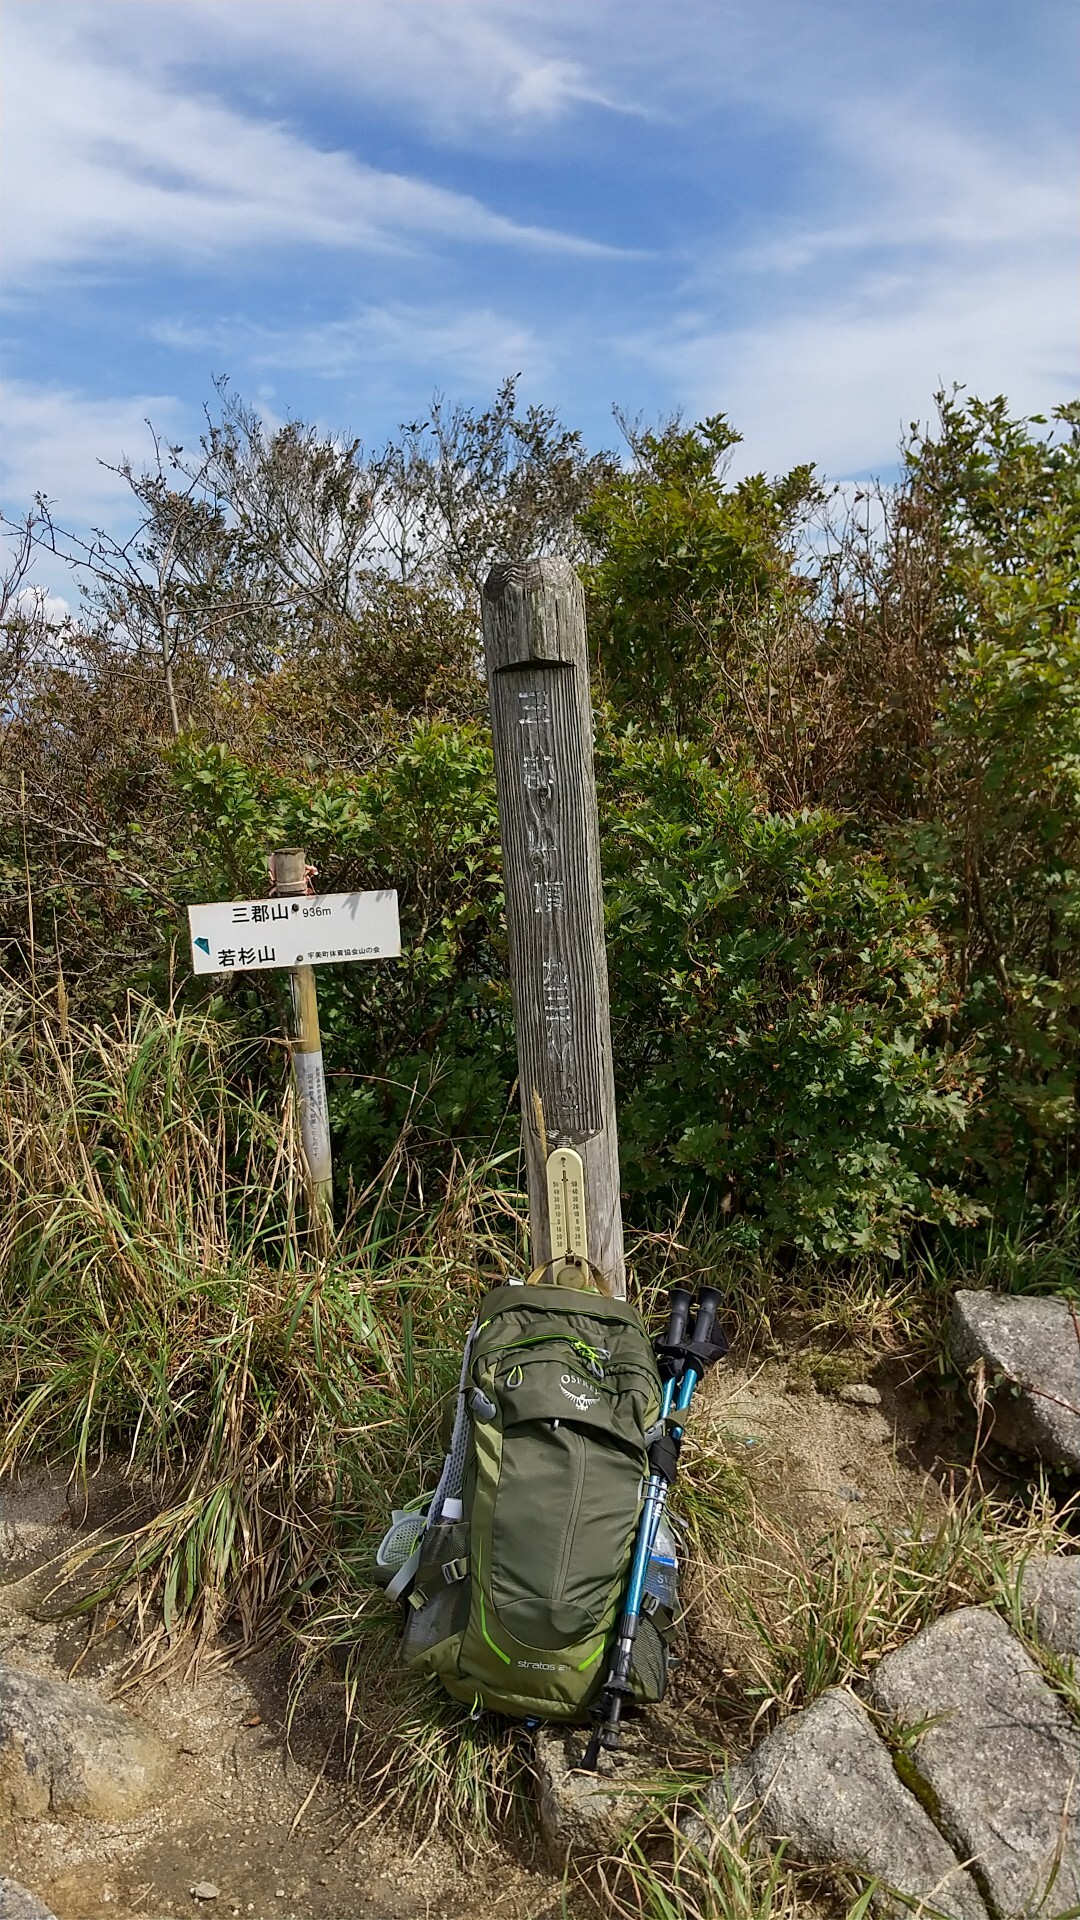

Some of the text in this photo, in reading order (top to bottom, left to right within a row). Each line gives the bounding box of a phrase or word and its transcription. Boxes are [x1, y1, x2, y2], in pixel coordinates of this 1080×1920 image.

[232, 903, 331, 923] 三郡山 936m
[217, 946, 275, 967] 若杉山
[560, 1374, 600, 1395] OSPREY
[517, 1660, 555, 1670] stratos
